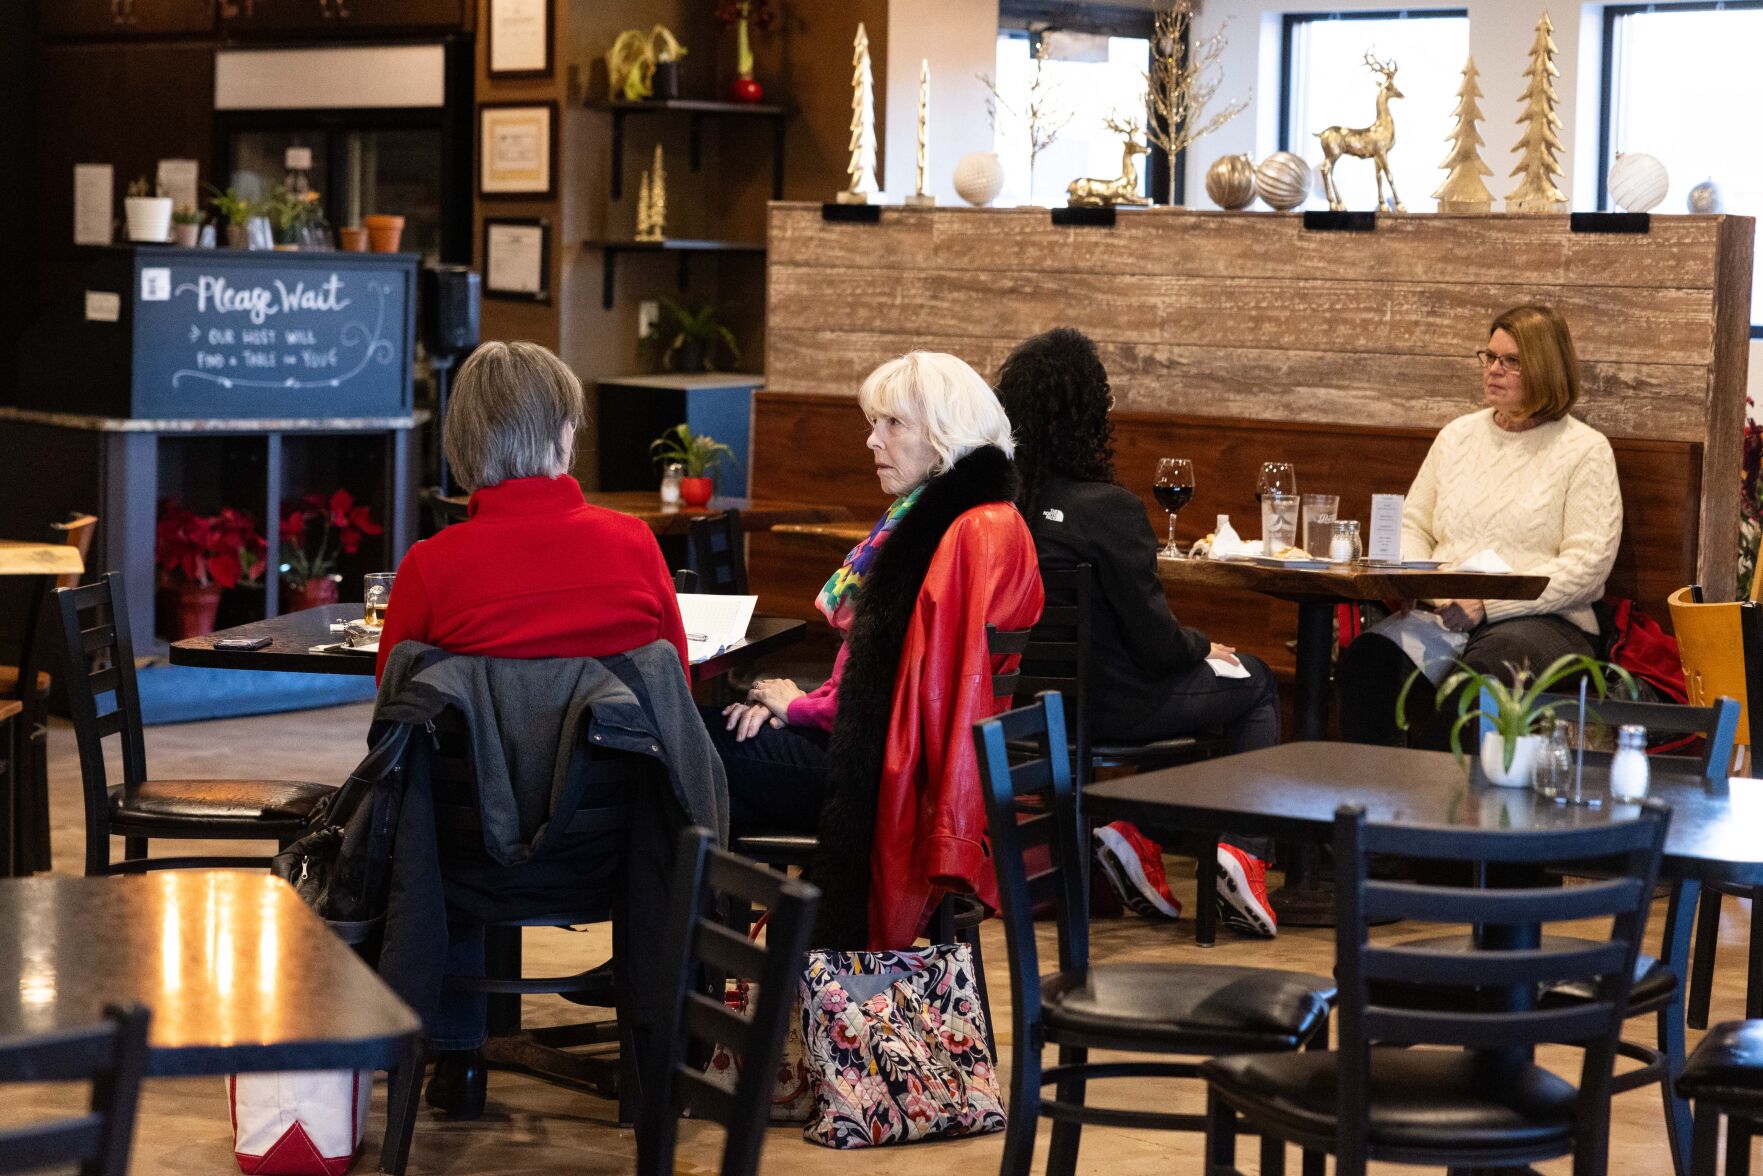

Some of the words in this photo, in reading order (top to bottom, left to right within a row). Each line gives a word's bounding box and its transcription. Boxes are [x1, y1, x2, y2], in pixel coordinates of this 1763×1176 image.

[197, 275, 279, 325] Please
[274, 273, 351, 313] Wait
[208, 328, 235, 345] OUR
[241, 328, 276, 345] HOST
[285, 328, 317, 345] WILL
